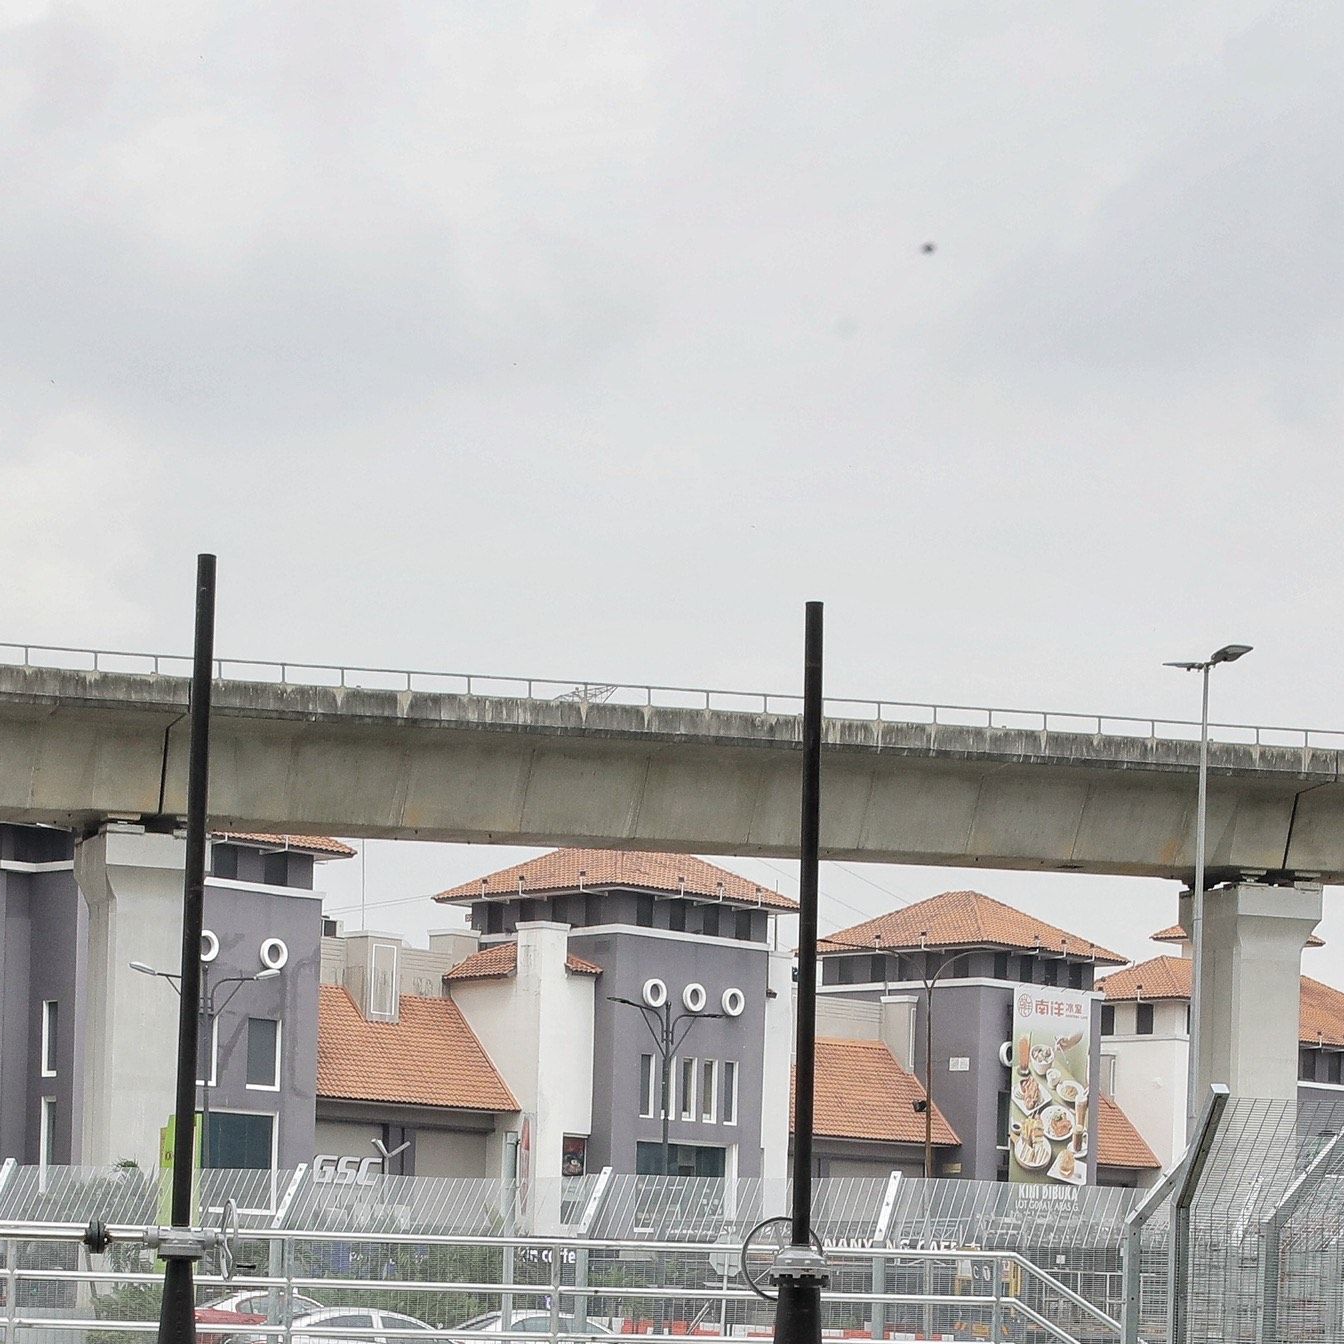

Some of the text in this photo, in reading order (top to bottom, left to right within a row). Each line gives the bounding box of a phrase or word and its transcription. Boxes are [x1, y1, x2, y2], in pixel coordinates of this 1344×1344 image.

[313, 1154, 383, 1186] GSC
[1018, 1184, 1077, 1201] KINI DIBUKA
